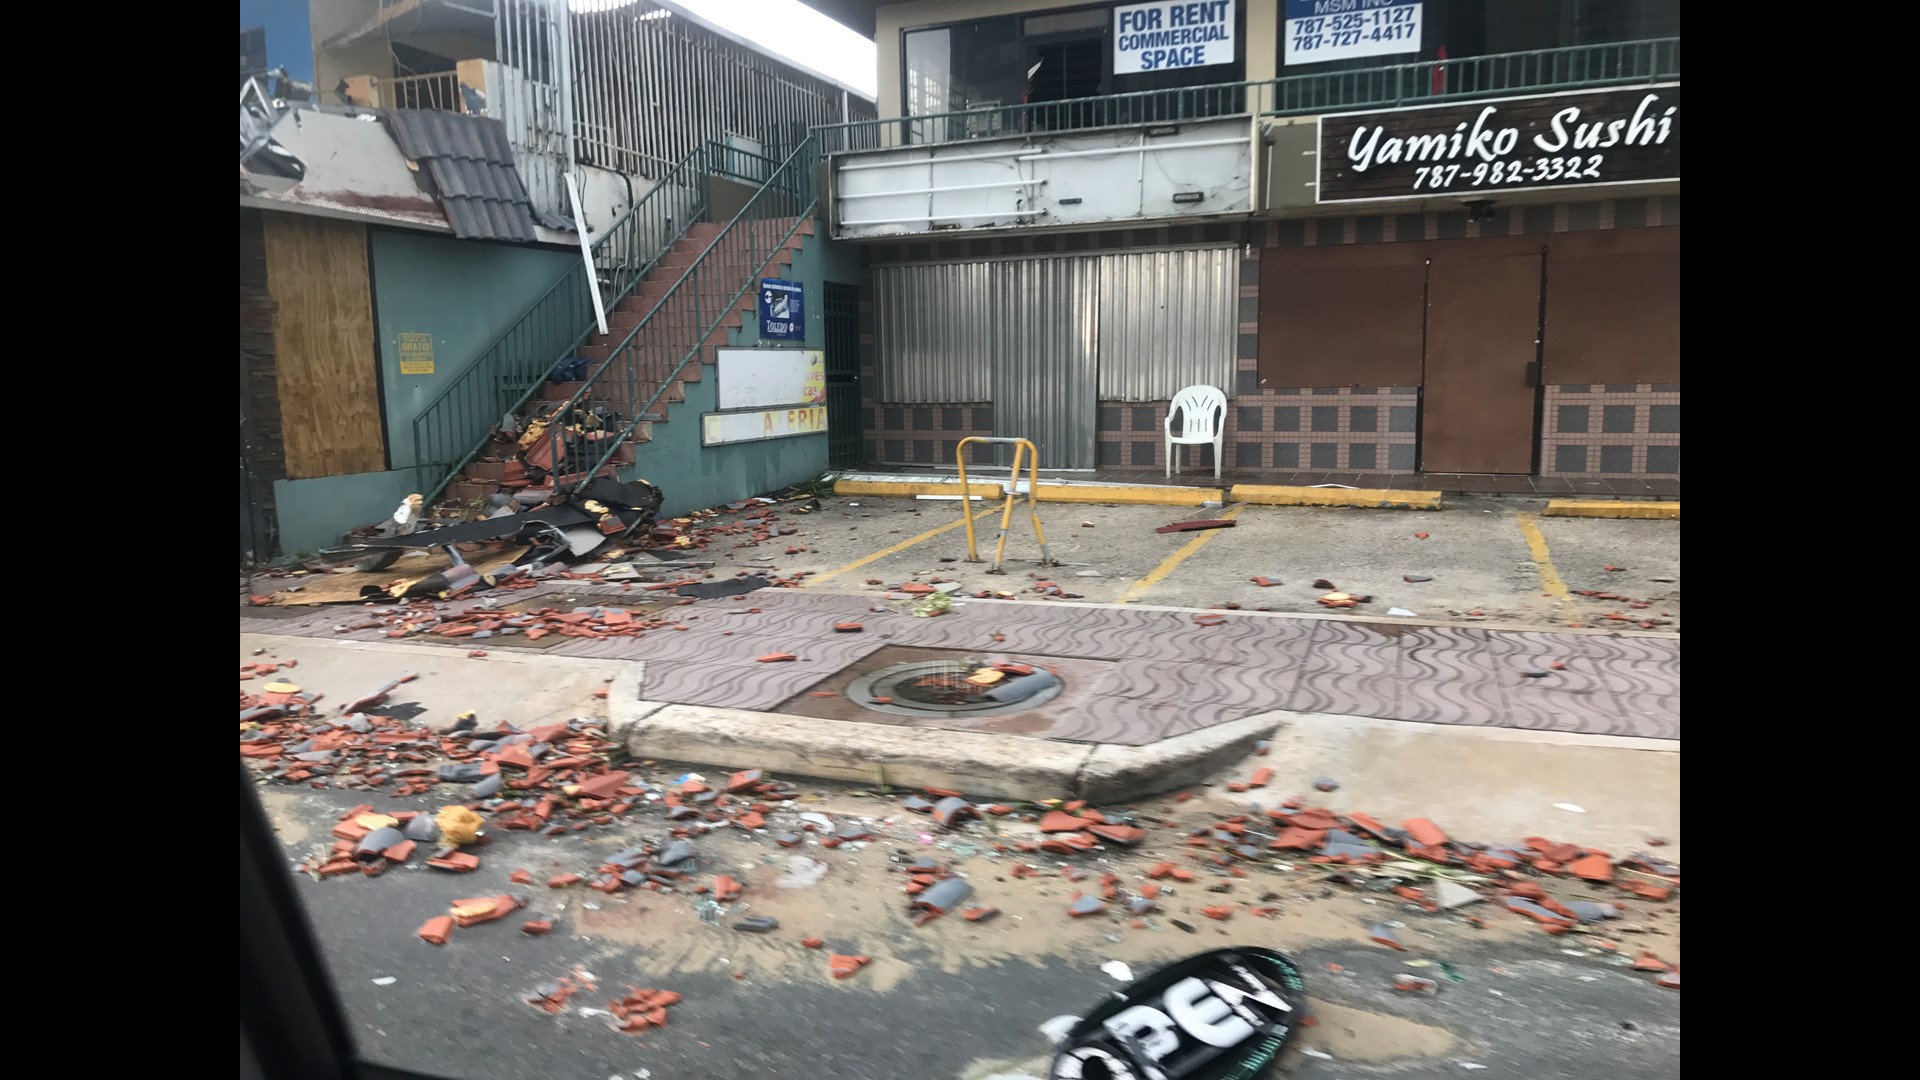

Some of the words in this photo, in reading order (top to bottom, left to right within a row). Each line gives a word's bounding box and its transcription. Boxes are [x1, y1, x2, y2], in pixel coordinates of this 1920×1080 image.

[1120, 8, 1162, 34] FOR
[1170, 0, 1230, 27] RENT
[1294, 6, 1415, 36] 787-525-1127
[1314, 0, 1357, 15] MSM
[1119, 24, 1230, 51] COMMERCIAL
[1292, 23, 1416, 52] 787-727-4417
[1141, 45, 1206, 70] SPACE
[1347, 106, 1519, 173] Yamiko
[1533, 93, 1678, 153] Sushi
[1412, 154, 1605, 190] 787-982-3322
